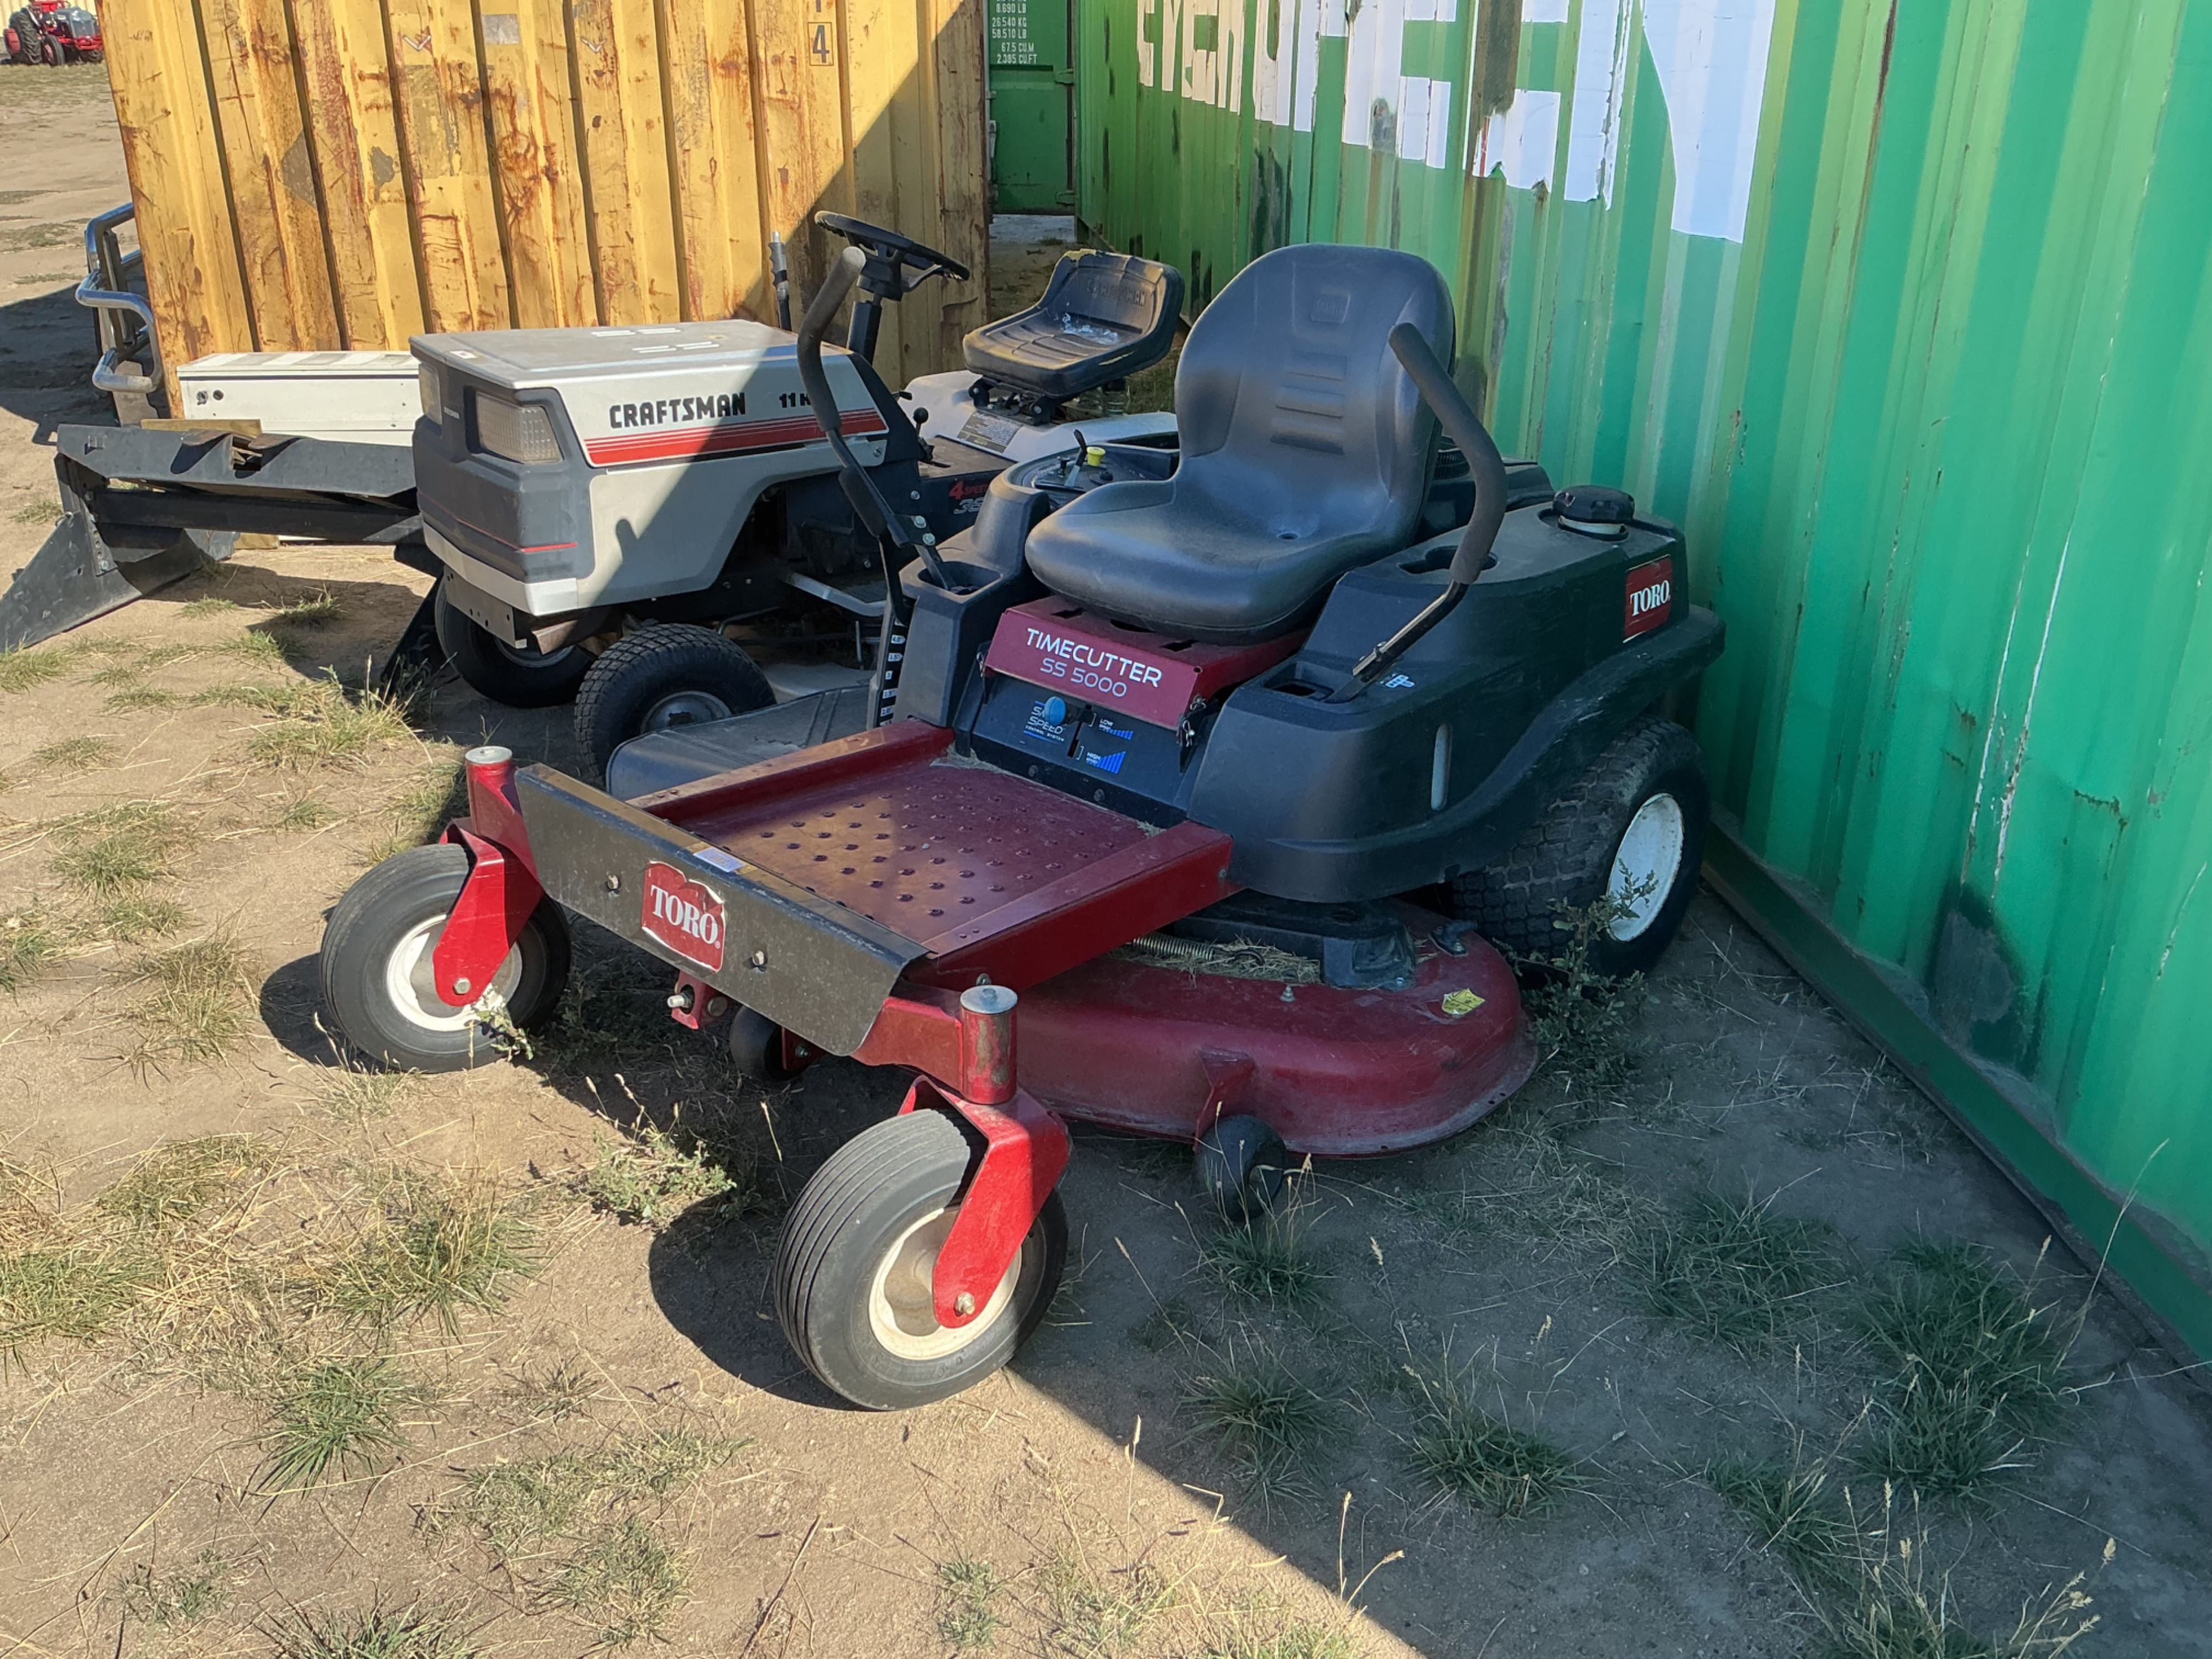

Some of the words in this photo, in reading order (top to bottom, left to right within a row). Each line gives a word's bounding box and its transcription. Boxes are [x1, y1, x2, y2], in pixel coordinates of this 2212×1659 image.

[1018, 3, 1027, 13] LB
[1018, 17, 1027, 27] KG
[812, 25, 830, 63] 4
[1018, 29, 1027, 39] LB
[609, 392, 746, 429] CRAFTSMAN
[779, 392, 796, 409] 11
[948, 481, 964, 500] 4
[964, 485, 989, 495] SPEE
[1630, 580, 1670, 617] TORO
[1026, 627, 1162, 688] TIMECUTTER
[1040, 657, 1068, 678] SS
[1070, 667, 1128, 697] 5000
[650, 885, 718, 945] TORO
